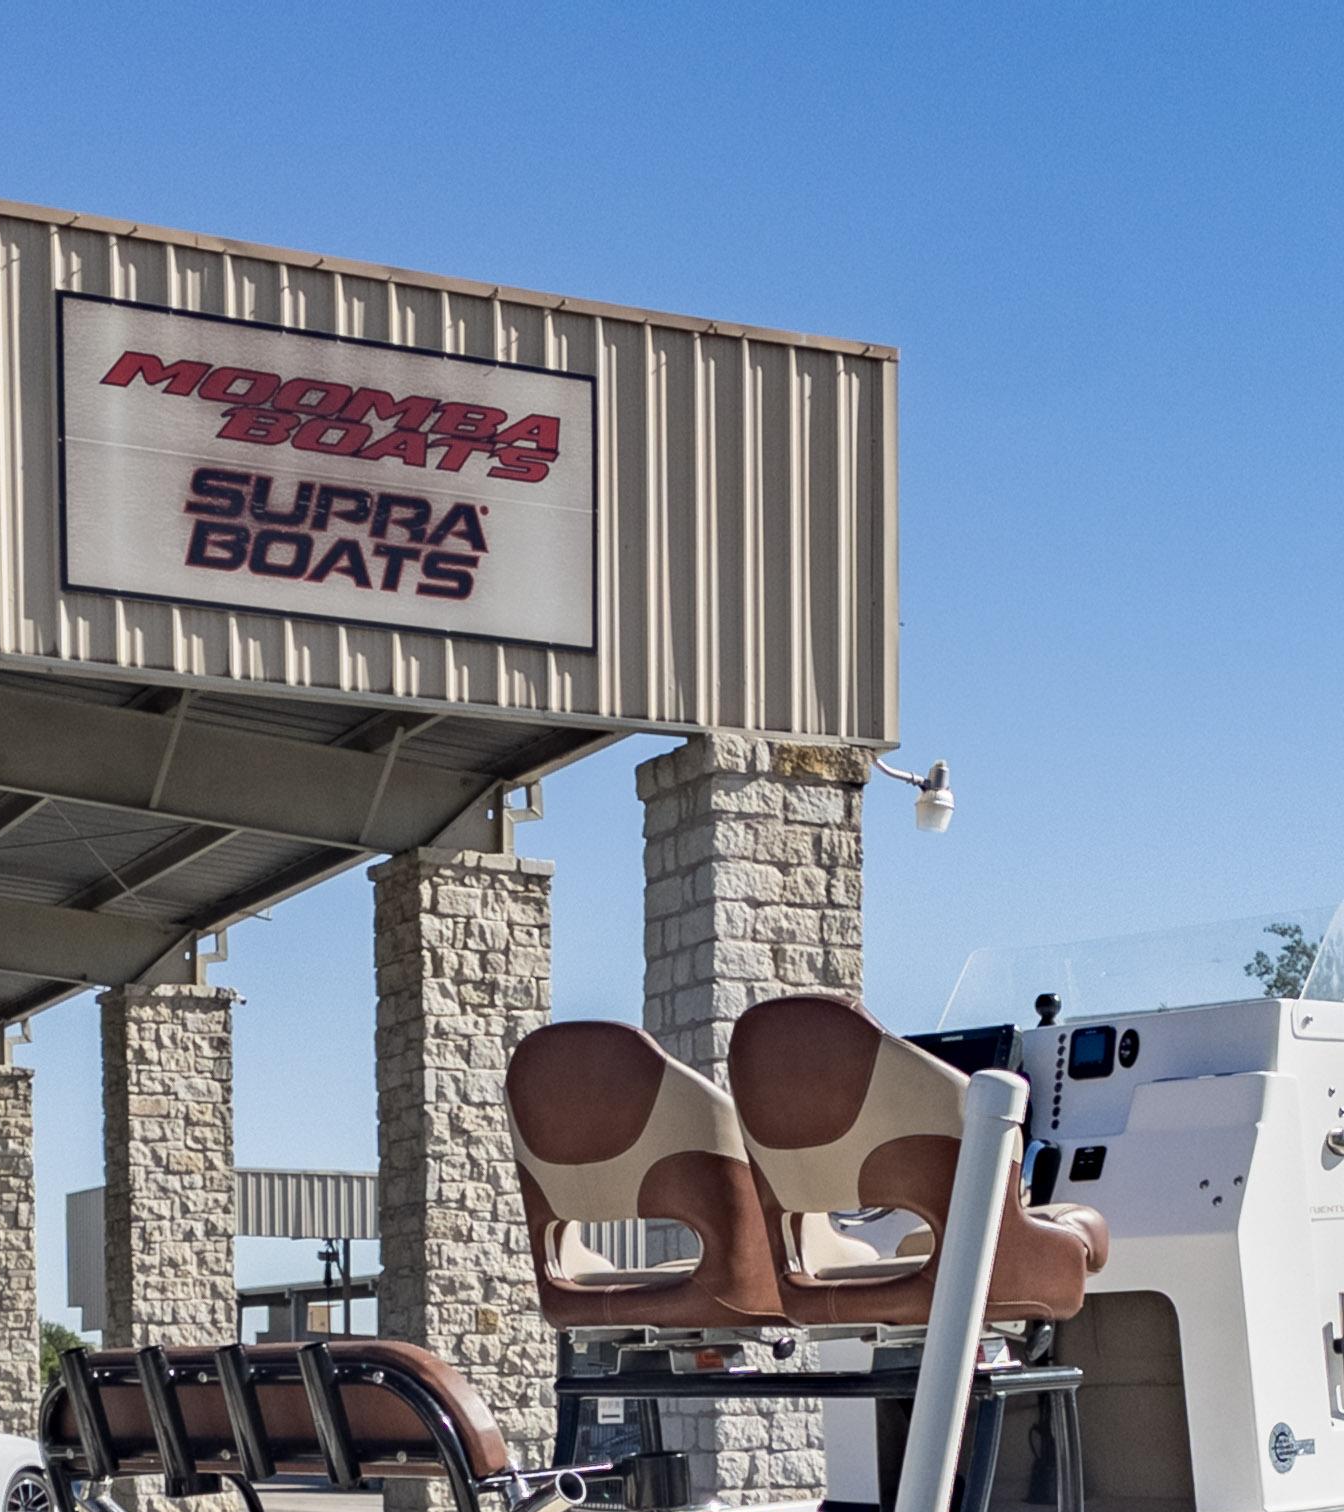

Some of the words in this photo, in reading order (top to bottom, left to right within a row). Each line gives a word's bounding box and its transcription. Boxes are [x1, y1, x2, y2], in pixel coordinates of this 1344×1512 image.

[99, 350, 561, 452] MOOMBA
[216, 405, 560, 483] BOATS
[183, 466, 489, 553] SUPRA
[184, 518, 480, 601] BOATS
